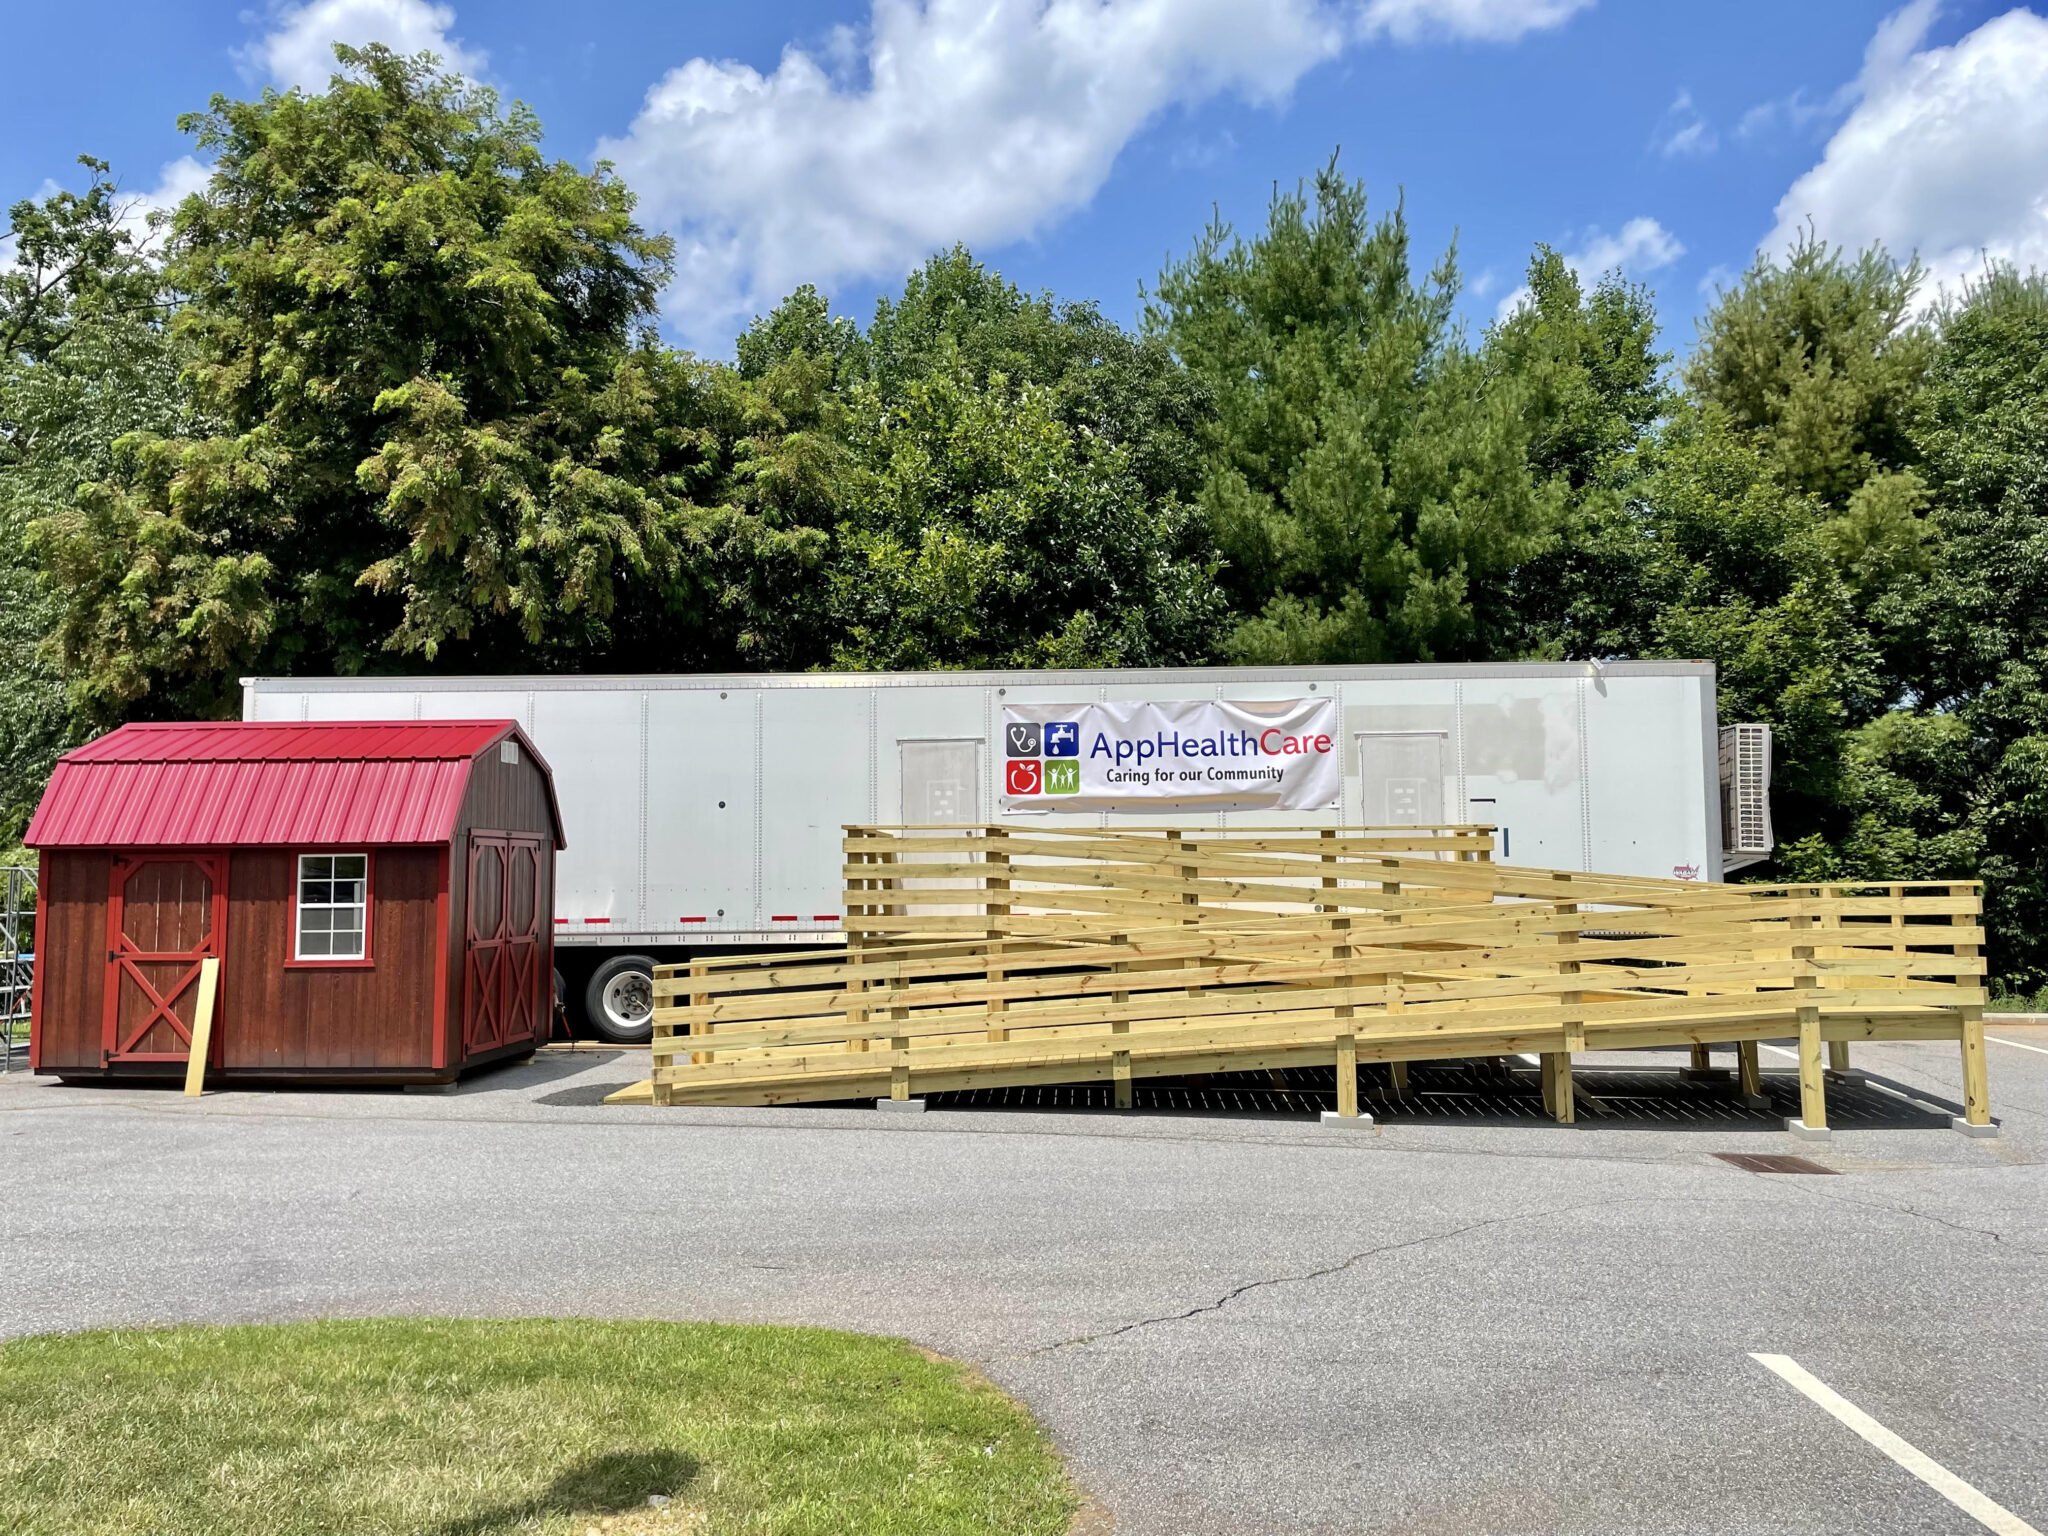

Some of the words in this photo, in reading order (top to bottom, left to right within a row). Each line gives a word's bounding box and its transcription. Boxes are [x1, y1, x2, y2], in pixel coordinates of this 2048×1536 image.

[1090, 728, 1331, 766] AppHealthCare
[1106, 769, 1150, 785] Caring
[1154, 768, 1175, 782] for
[1179, 769, 1203, 781] our
[1207, 766, 1284, 783] Community
